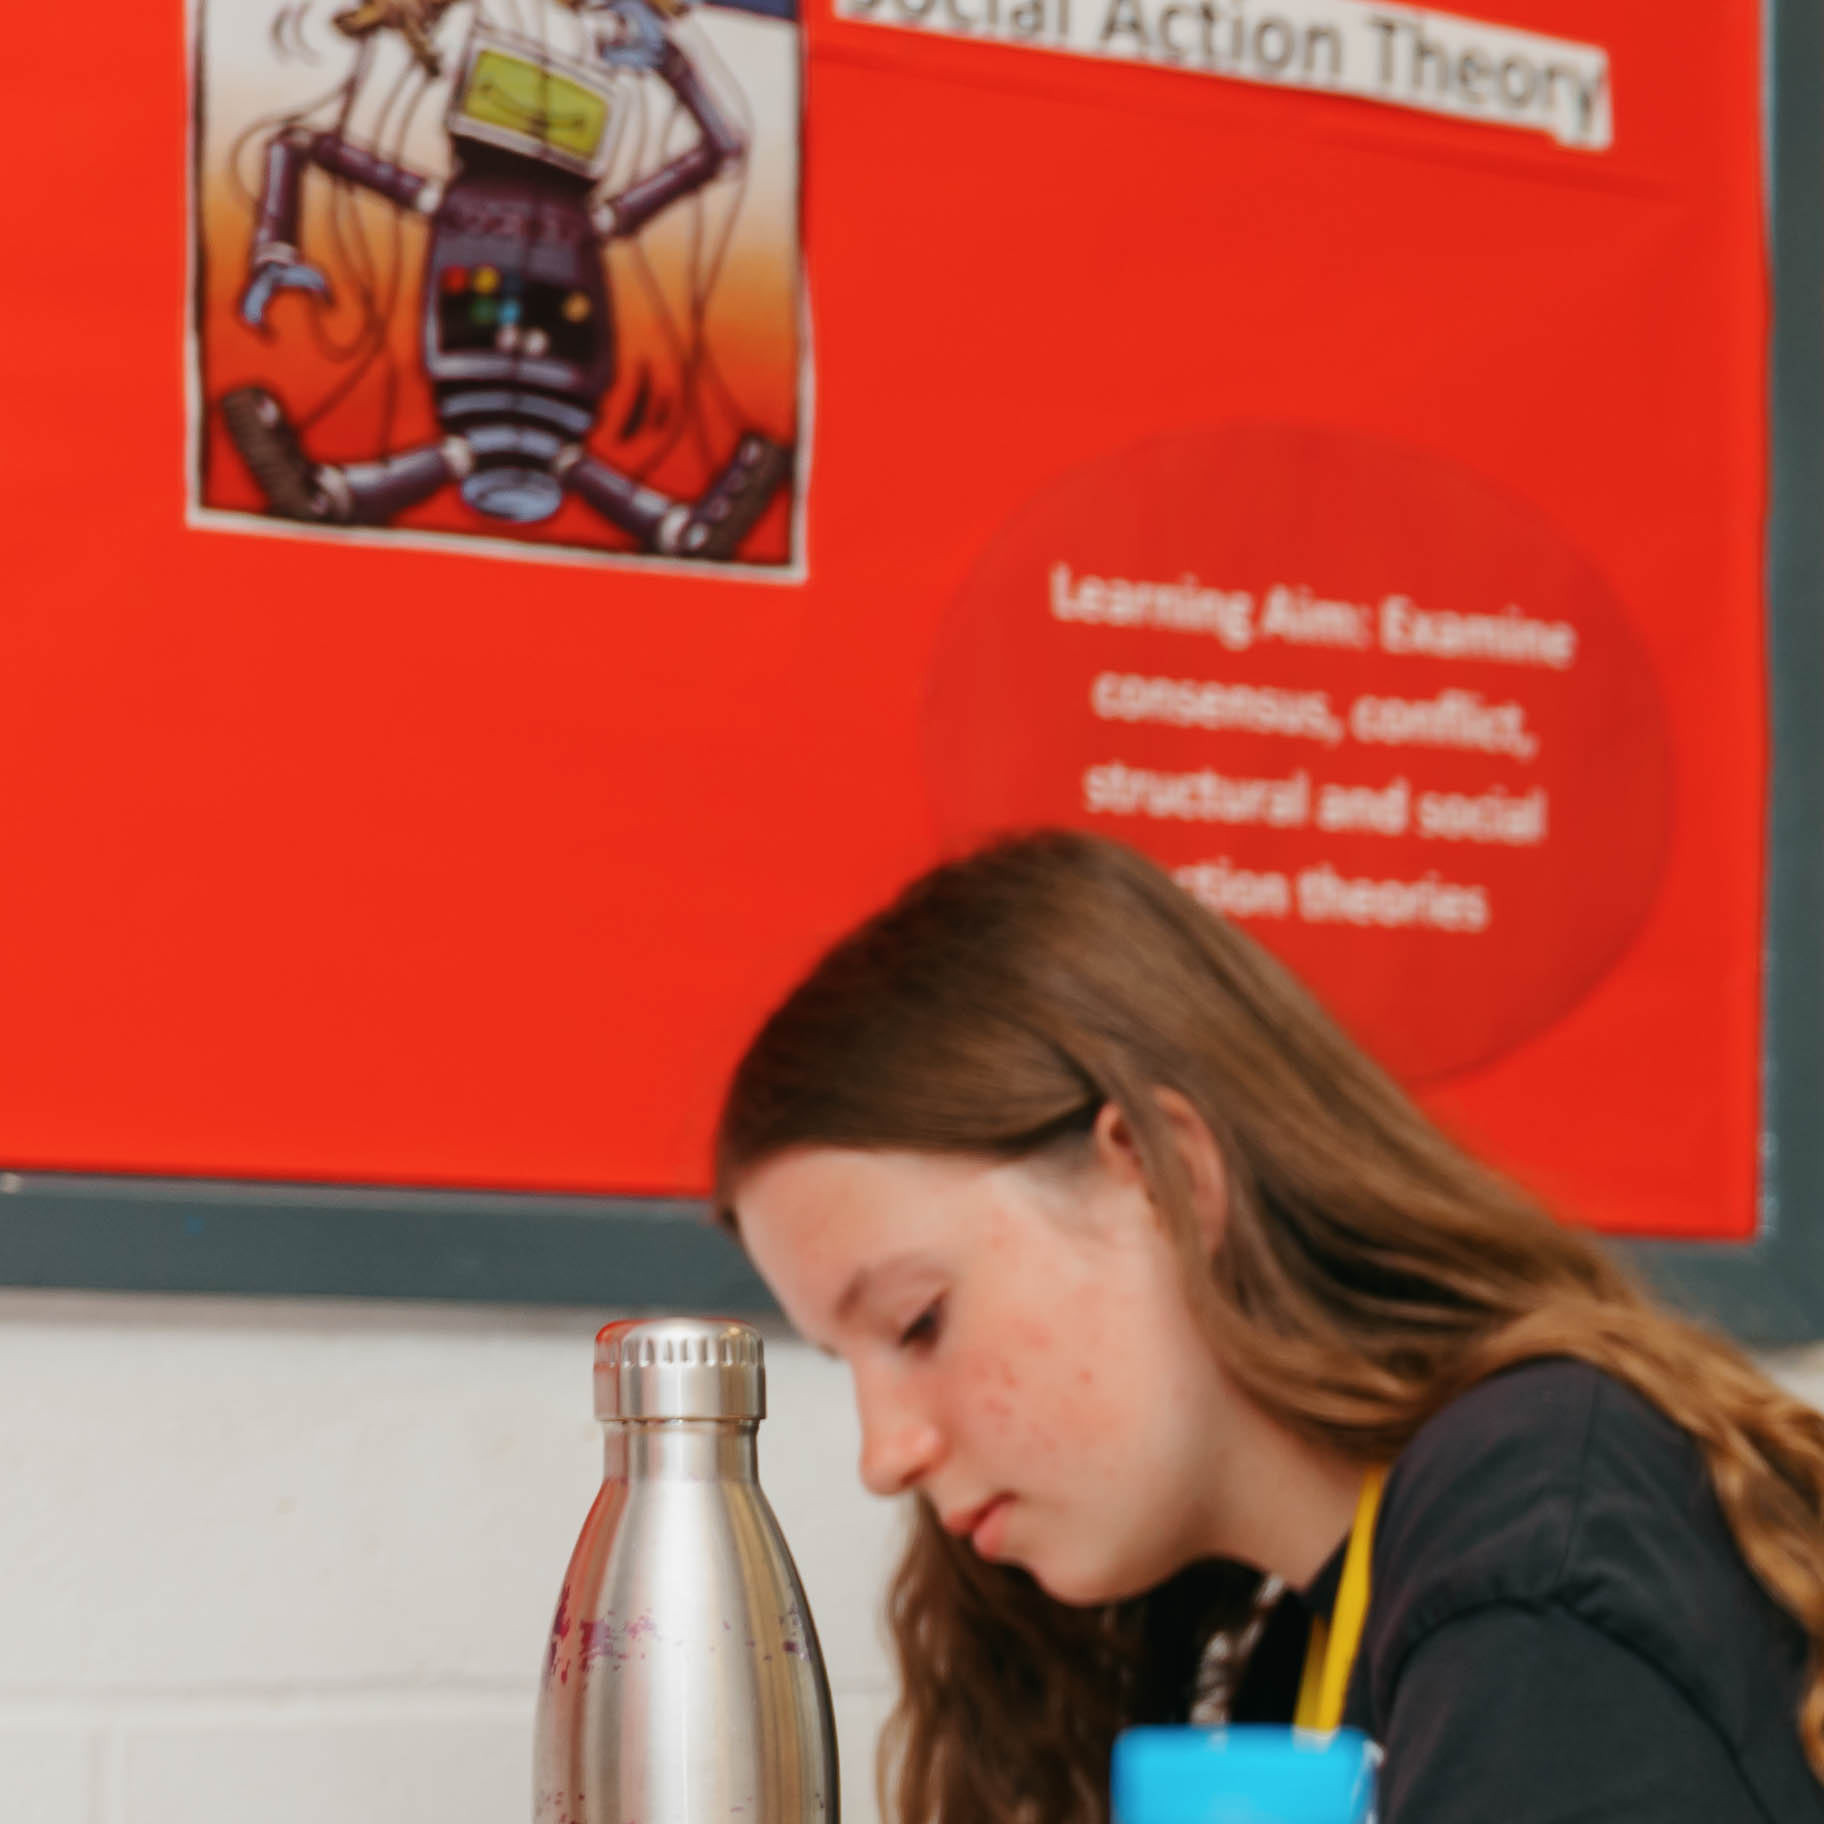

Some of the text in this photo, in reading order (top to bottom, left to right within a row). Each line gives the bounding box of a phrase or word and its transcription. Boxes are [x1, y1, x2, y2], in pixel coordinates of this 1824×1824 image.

[1098, 0, 1343, 78] Action
[1366, 14, 1606, 134] Theory
[1050, 561, 1576, 669] Learning Aim: Examine
[1092, 671, 1538, 761] consensus, conflict,
[1085, 760, 1546, 844] structural and social
[1174, 857, 1489, 932] tion theories
